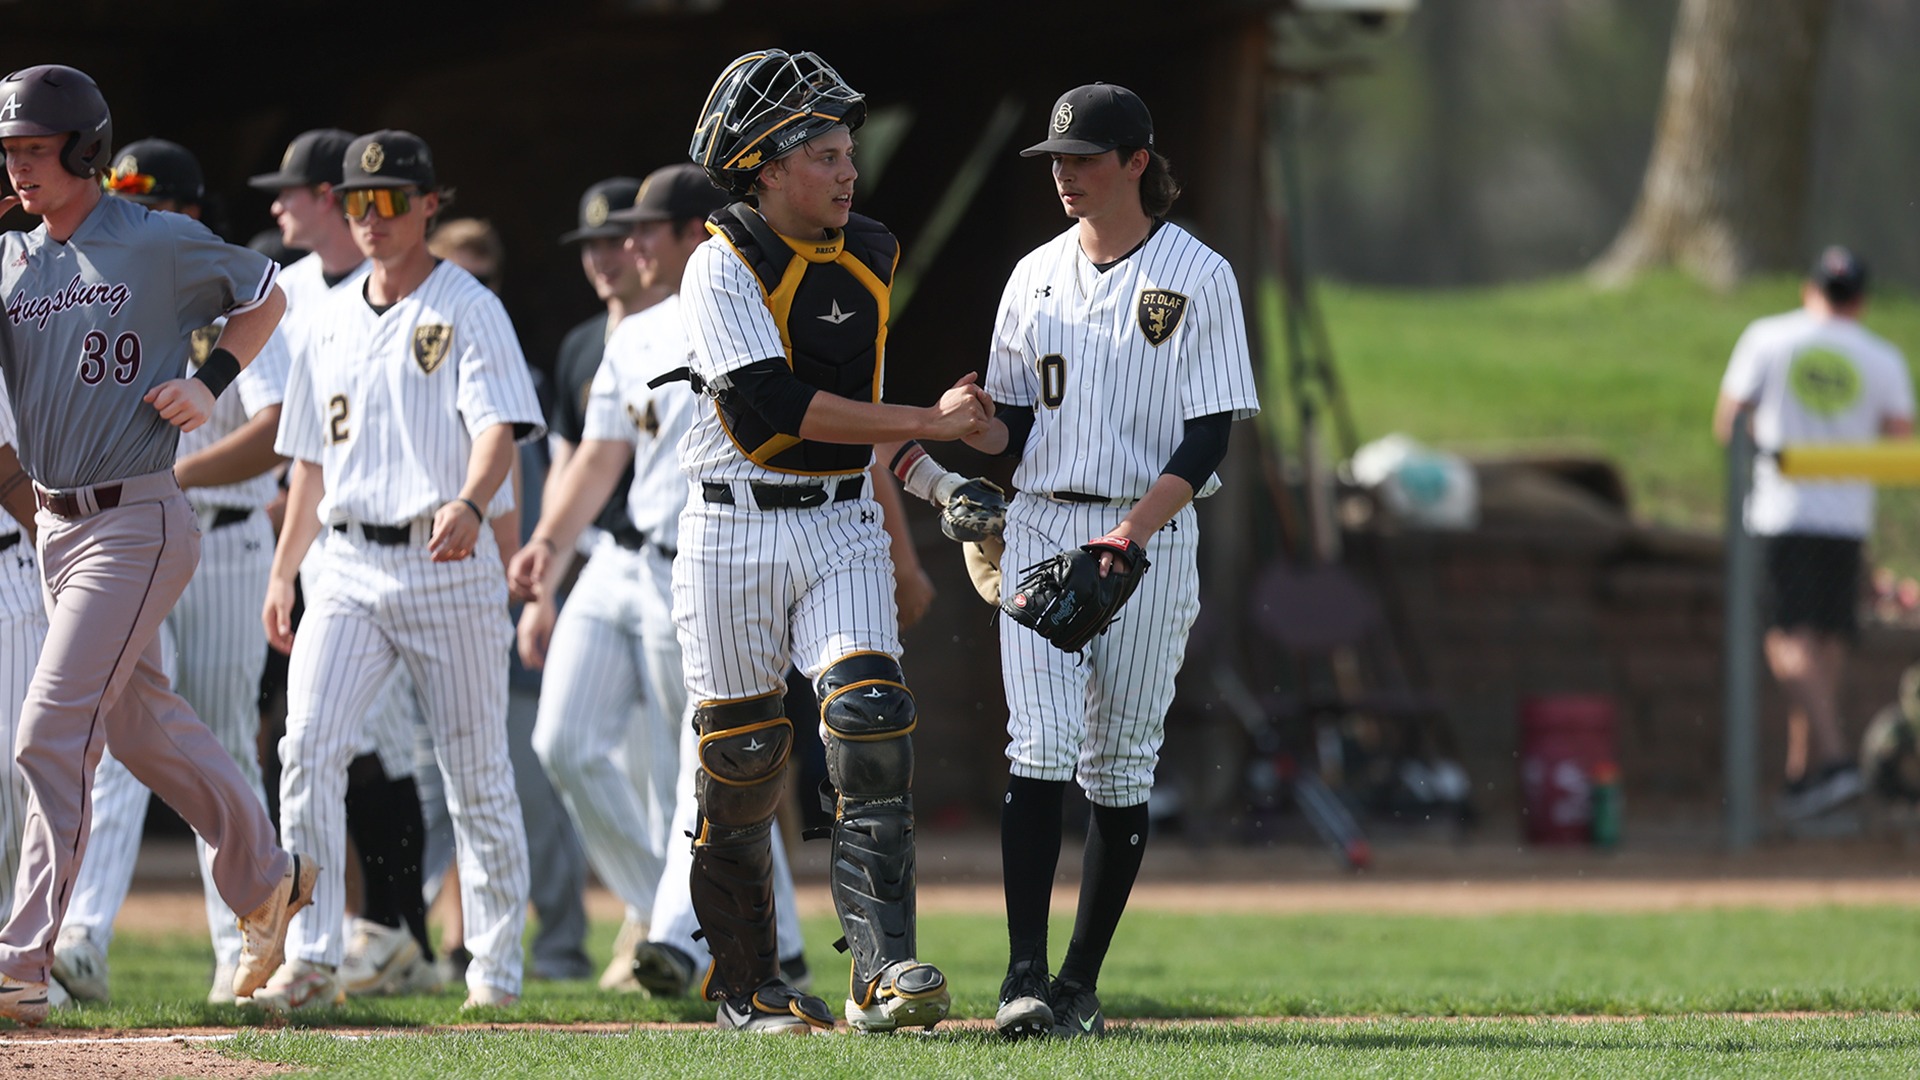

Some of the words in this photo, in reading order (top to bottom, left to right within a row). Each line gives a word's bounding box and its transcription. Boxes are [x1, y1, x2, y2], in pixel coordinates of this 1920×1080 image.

[0, 92, 22, 120] A
[8, 272, 131, 331] Augsburg
[1143, 294, 1156, 304] ST.
[1157, 294, 1181, 309] OLAF
[80, 330, 142, 386] 39
[1033, 353, 1067, 413] 0
[322, 394, 350, 447] 2
